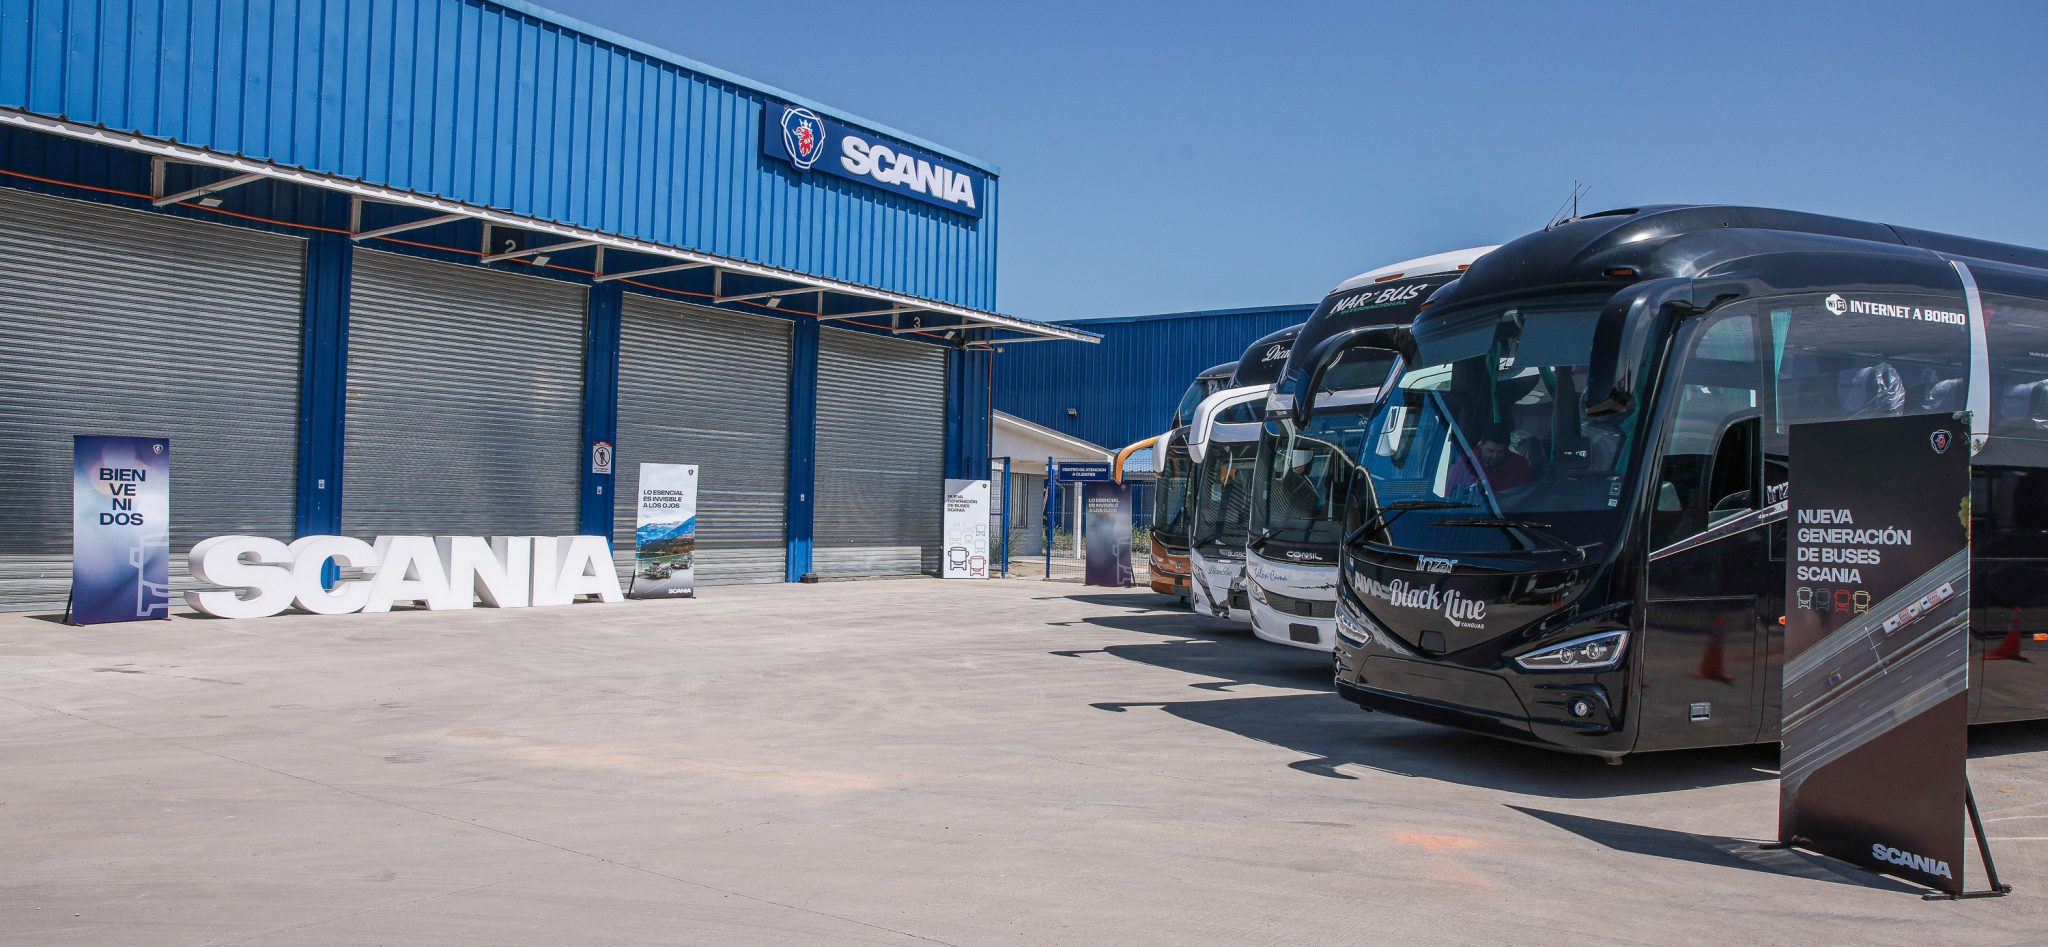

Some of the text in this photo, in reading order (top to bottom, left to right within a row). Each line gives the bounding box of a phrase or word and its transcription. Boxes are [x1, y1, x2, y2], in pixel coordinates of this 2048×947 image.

[841, 135, 976, 209] SCANIA
[504, 239, 517, 254] 2
[1330, 283, 1428, 314] NAR BUS
[1850, 300, 1911, 319] INTERNET
[1912, 308, 1923, 321] A
[1924, 309, 1967, 326] BORDO
[913, 316, 921, 329] 3
[99, 467, 146, 482] BIEN
[109, 482, 136, 496] VE
[112, 497, 132, 511] NI
[99, 512, 144, 526] DOS
[1797, 509, 1854, 524] NUEVA
[1797, 525, 1911, 545] GENERACIÓN
[1286, 550, 1323, 561] COMIL
[1797, 547, 1881, 565] DE BUSES
[184, 535, 625, 619] SCANIA
[1796, 566, 1862, 584] SCANIA
[1389, 578, 1487, 628] Black Line
[1461, 621, 1485, 630] YANGUAS
[1872, 843, 1953, 880] SCANIA
